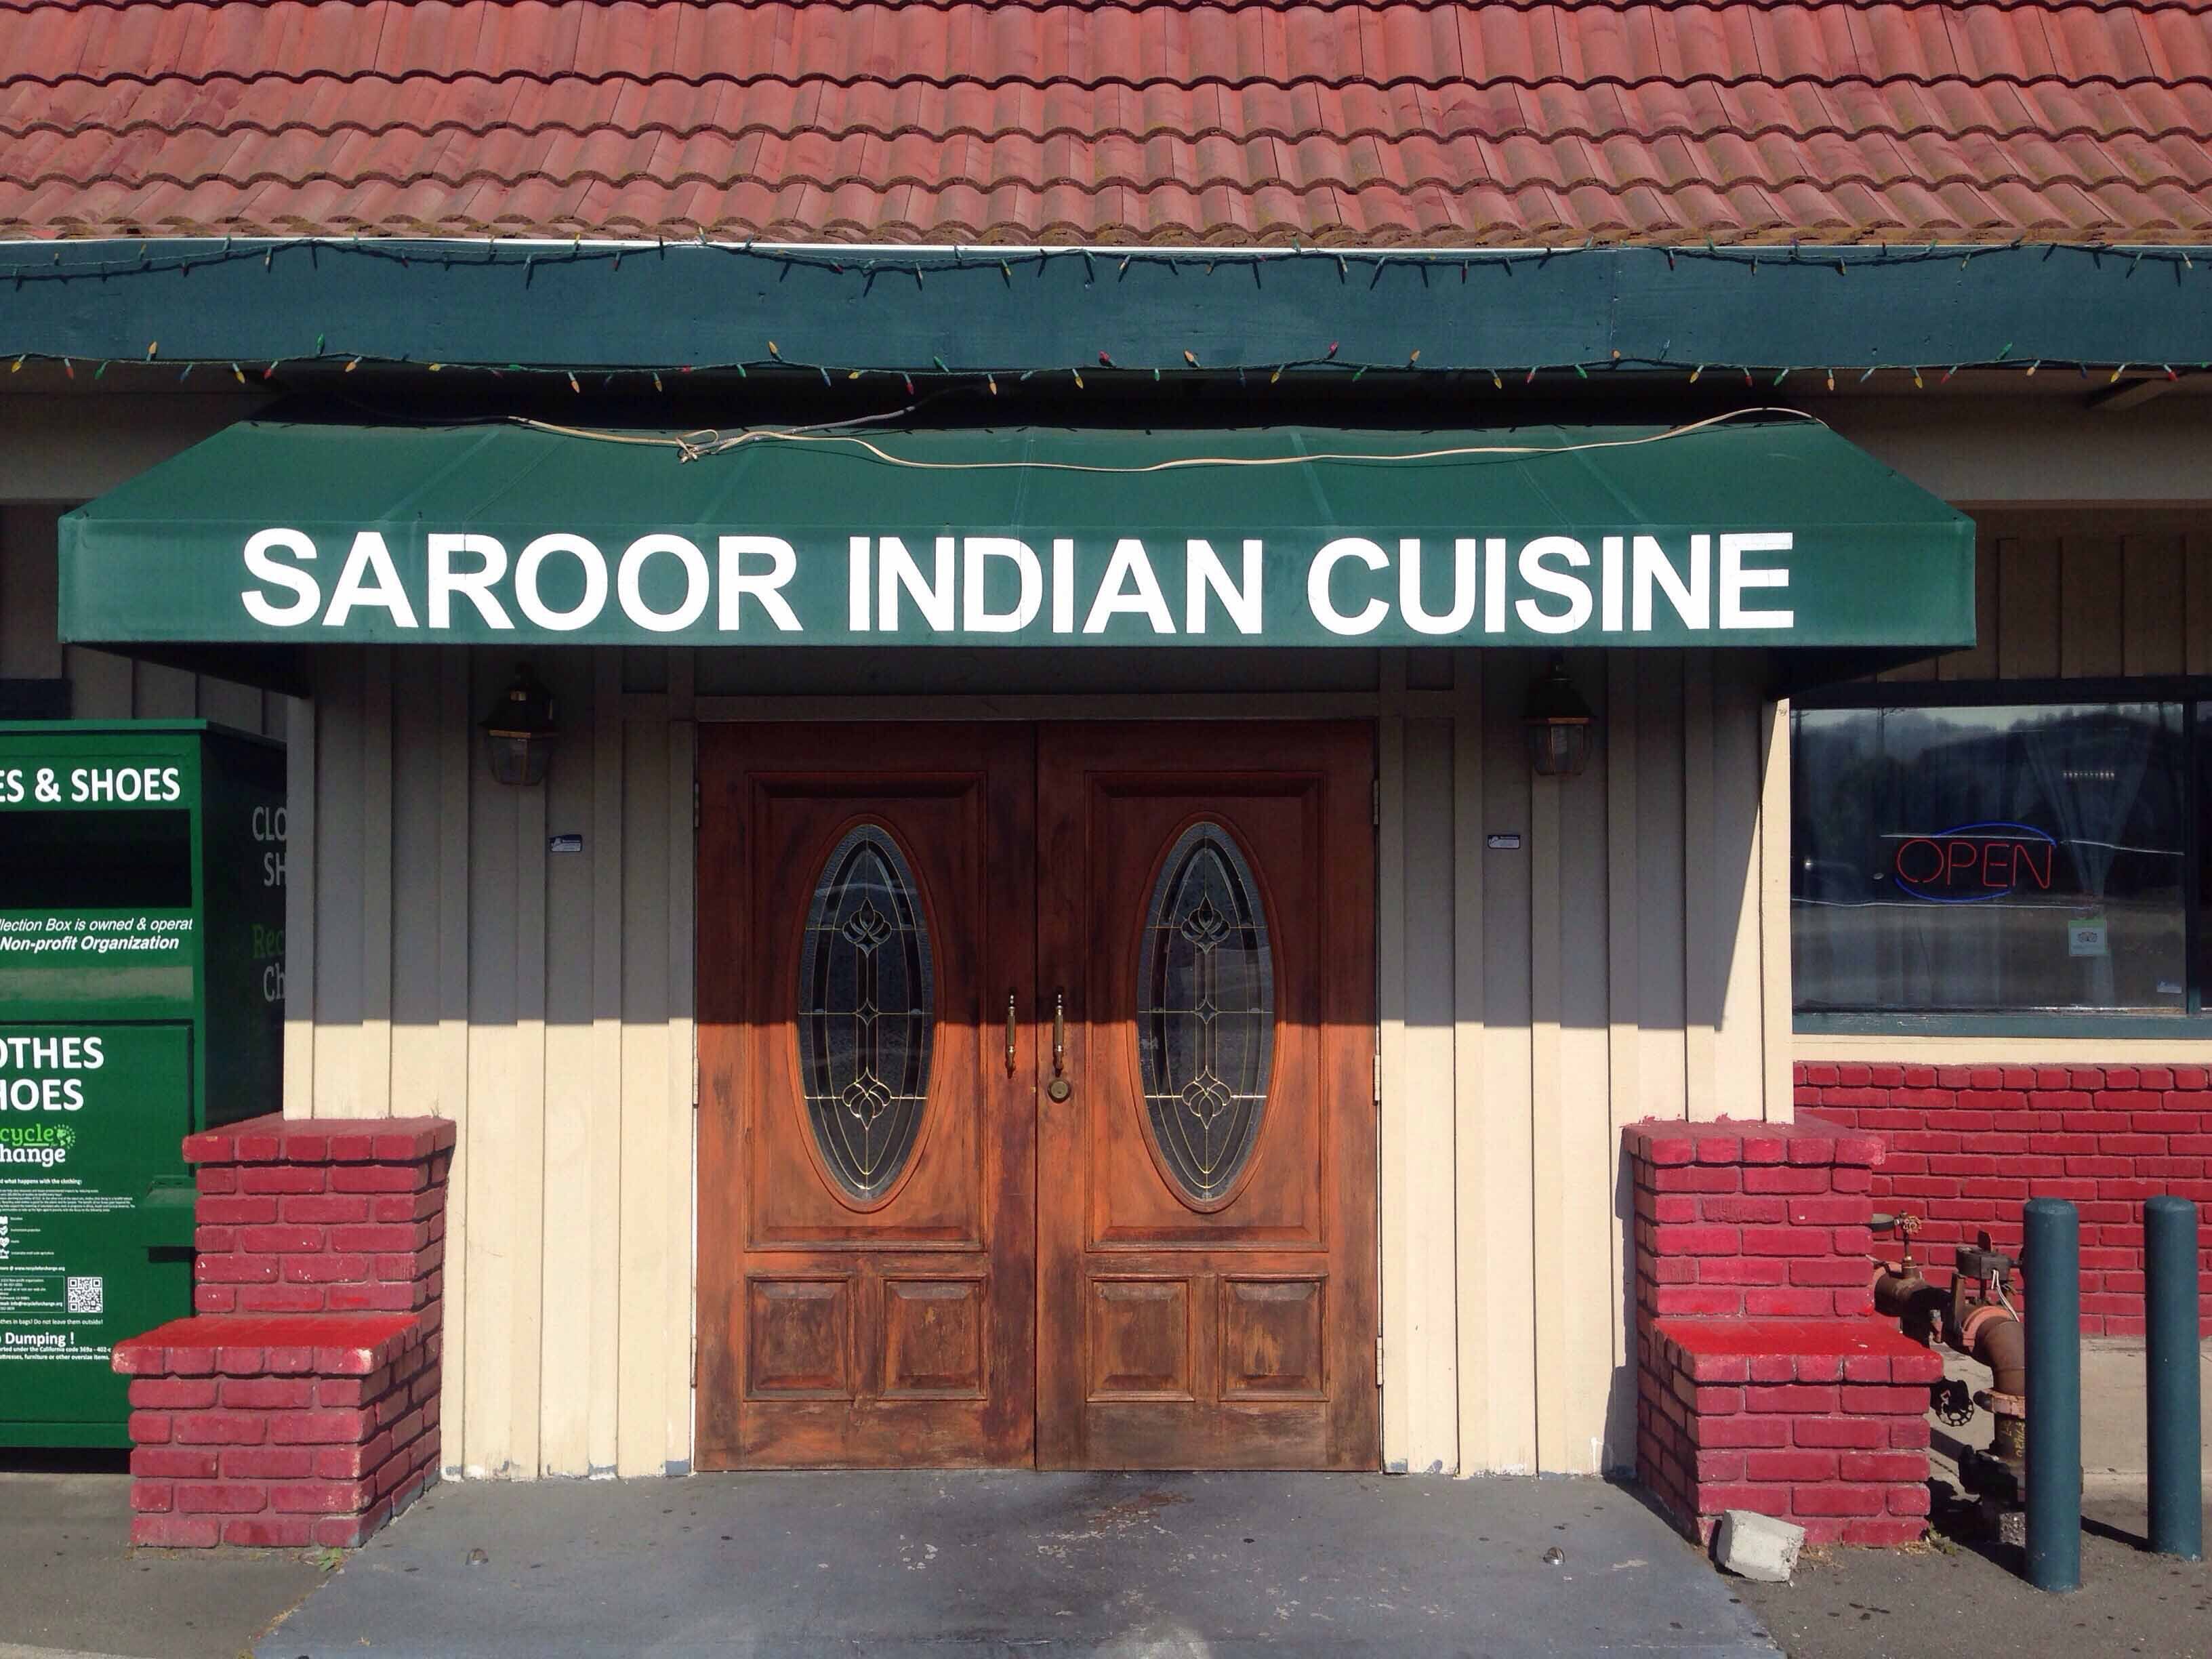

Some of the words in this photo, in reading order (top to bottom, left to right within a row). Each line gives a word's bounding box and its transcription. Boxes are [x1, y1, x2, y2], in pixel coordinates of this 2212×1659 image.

[241, 528, 804, 632] SAROOR
[848, 536, 1263, 634] INDIAN
[1307, 532, 1795, 636] CUISINE
[35, 769, 62, 802] &
[71, 768, 181, 802] SHOES
[1897, 838, 2053, 890] OPEN
[45, 918, 71, 932] Box
[75, 918, 86, 931] is
[89, 918, 134, 931] owned
[136, 917, 147, 930] &
[0, 935, 79, 954] Non-profit
[81, 935, 180, 954] Organization
[5, 1332, 66, 1347] Dumping
